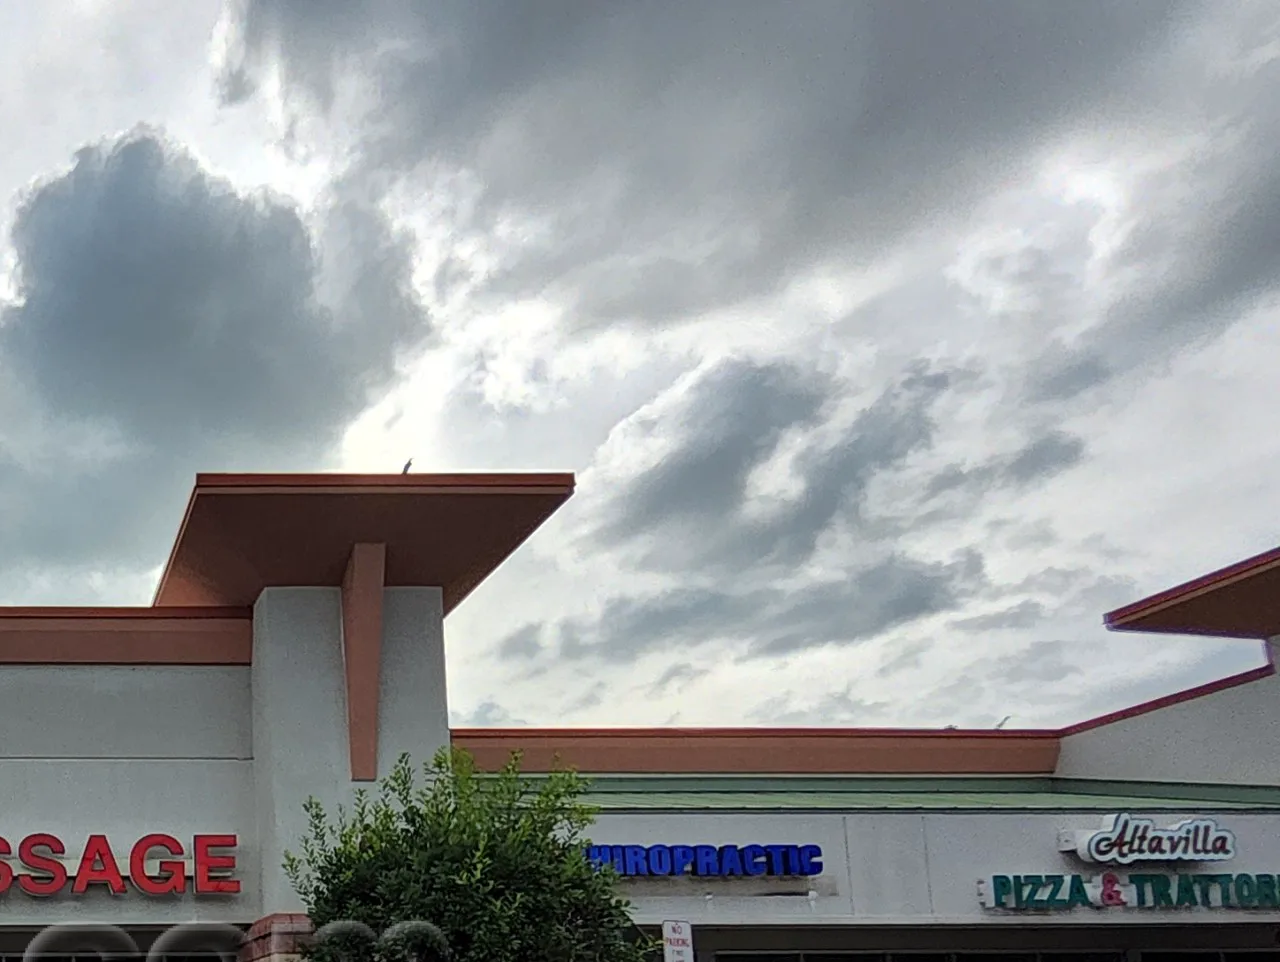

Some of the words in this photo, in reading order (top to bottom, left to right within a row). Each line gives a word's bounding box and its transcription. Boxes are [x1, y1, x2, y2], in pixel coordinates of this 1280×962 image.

[1092, 820, 1231, 858] Altavilla
[582, 845, 824, 876] HIROPRACTIC
[992, 874, 1090, 907] PIZZA
[1100, 872, 1125, 906] &
[1128, 873, 1280, 908] TRATTOR
[671, 925, 682, 935] NO
